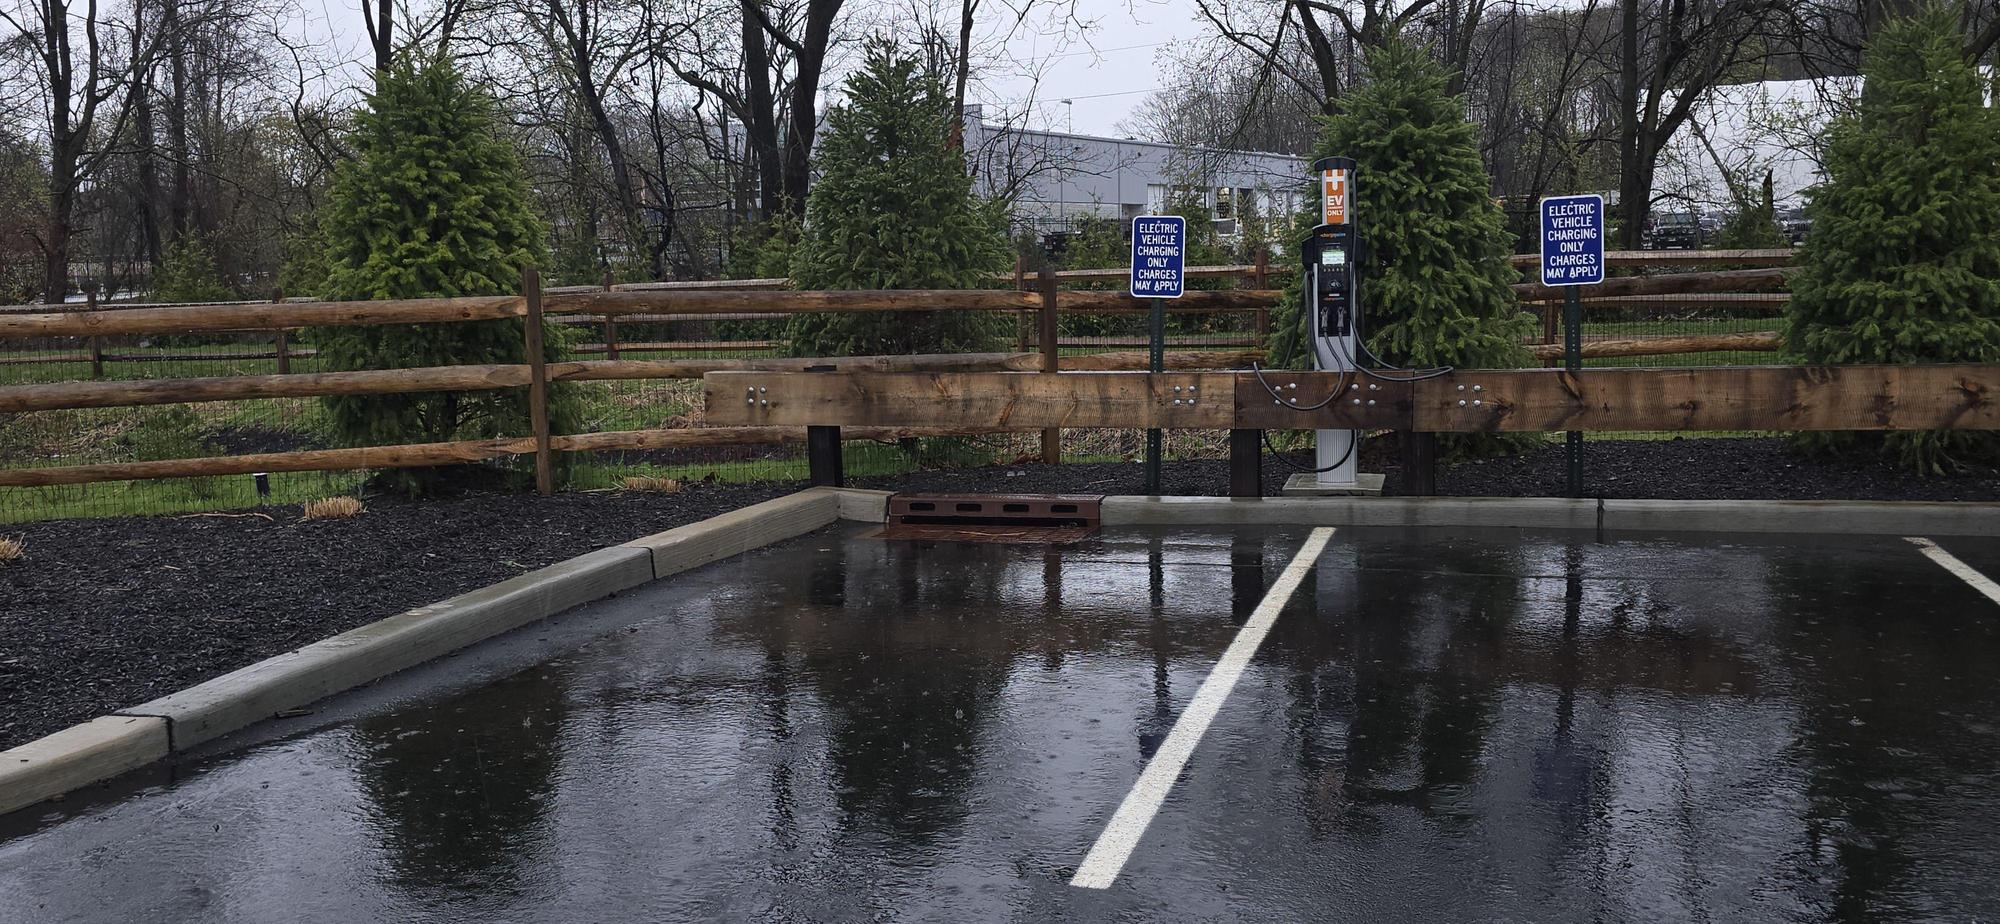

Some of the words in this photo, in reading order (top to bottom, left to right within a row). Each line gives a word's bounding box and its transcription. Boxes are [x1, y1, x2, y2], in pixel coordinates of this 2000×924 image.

[1327, 195, 1343, 206] EV
[1549, 203, 1595, 216] ELECTRIC
[1552, 216, 1592, 228] VEHICLE
[1140, 223, 1178, 234] ELECTRIC
[1142, 235, 1176, 245] VEHICLE
[1548, 228, 1597, 241] CHARGING
[1138, 246, 1179, 256] CHARGING
[1560, 241, 1584, 252] ONLY
[1148, 258, 1168, 267] ONLY
[1550, 254, 1595, 266] CHARGES
[1139, 270, 1177, 280] CHARGES
[1547, 267, 1565, 279] MAY
[1569, 266, 1598, 279] APPLY
[1135, 281, 1151, 291] MAY
[1154, 281, 1179, 291] APPLY
